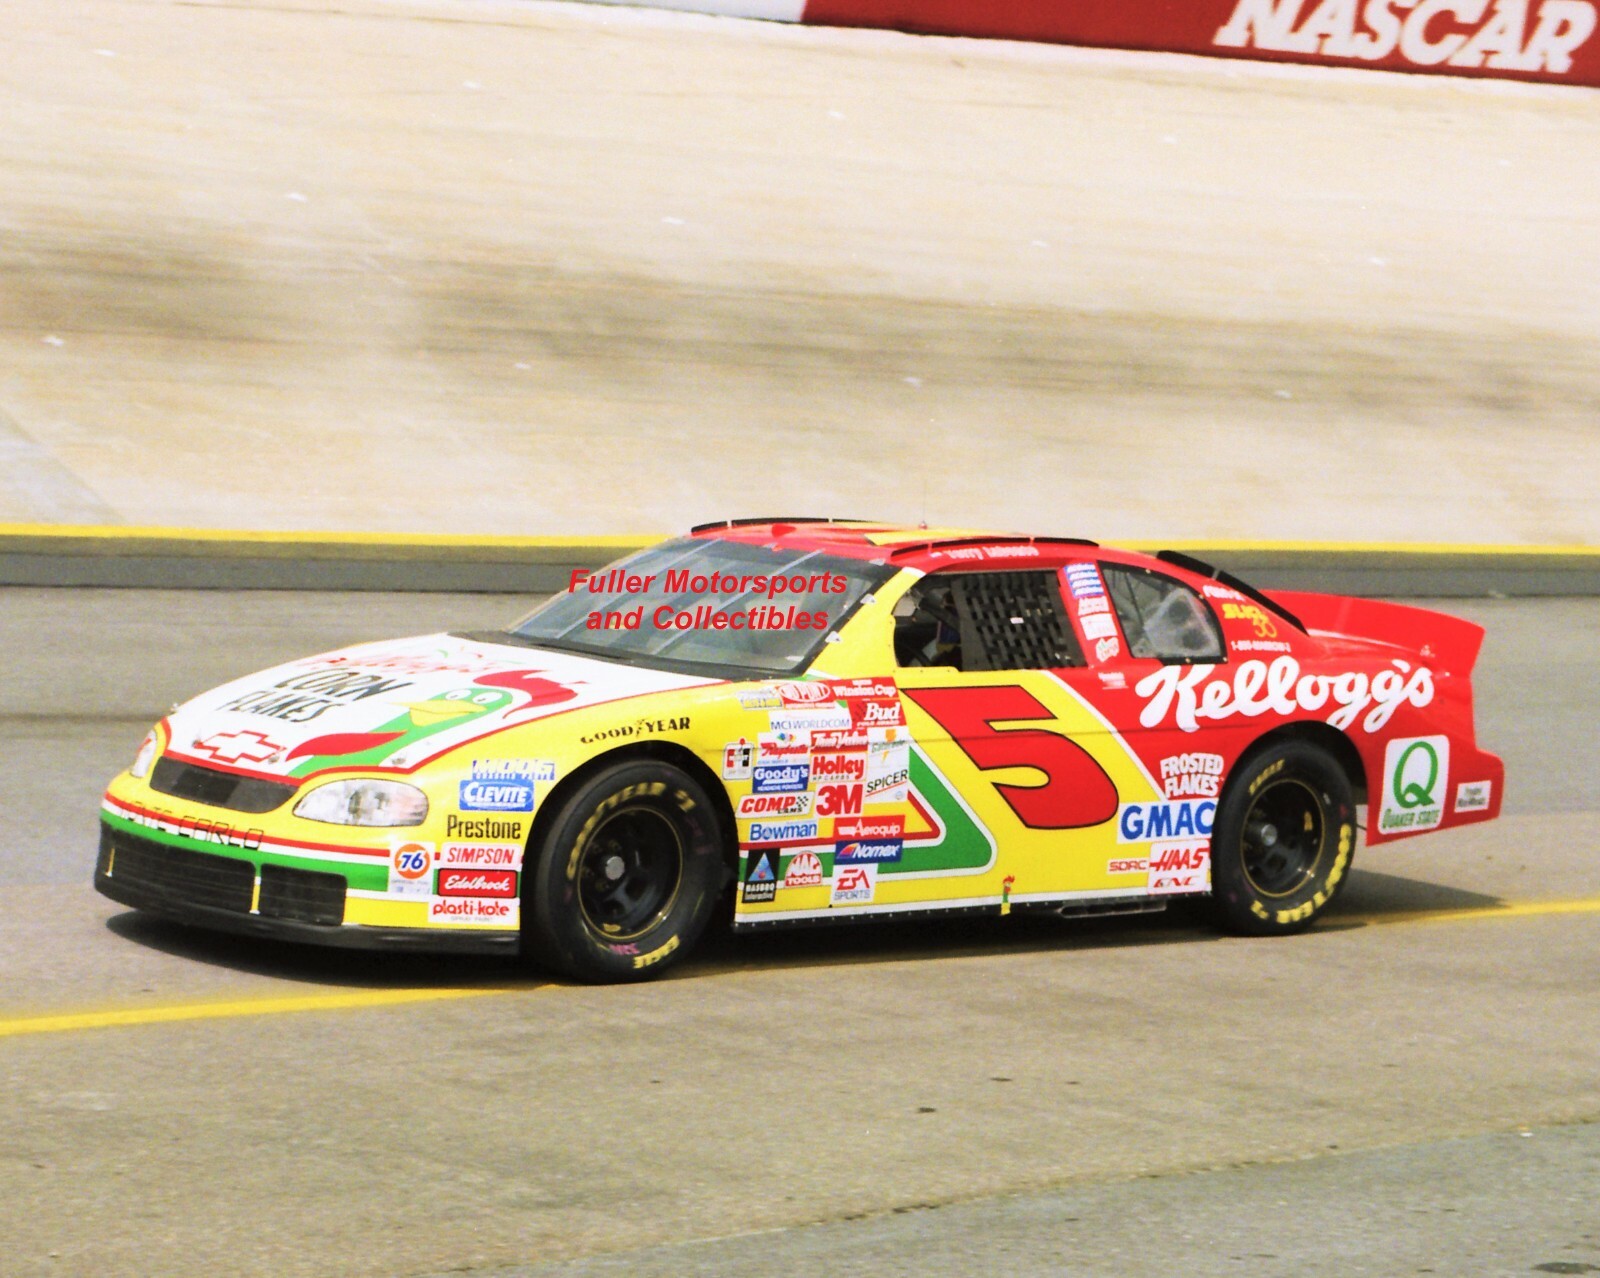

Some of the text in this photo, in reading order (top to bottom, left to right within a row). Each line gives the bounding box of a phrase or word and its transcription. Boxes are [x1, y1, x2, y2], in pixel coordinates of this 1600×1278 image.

[1212, 0, 1597, 74] NASCAR
[275, 667, 413, 701] CORN
[1135, 655, 1434, 733] Kellogg's
[216, 690, 345, 722] FLAKES
[864, 701, 901, 720] Bud
[813, 755, 864, 779] Holley
[899, 684, 1119, 831] 5
[1160, 753, 1224, 778] FROSTED
[754, 766, 809, 785] Goody's
[866, 769, 908, 793] SPICER
[1164, 775, 1219, 799] FLAKES
[741, 796, 796, 814] COMP
[815, 784, 863, 816] 3M
[446, 815, 521, 839] Prestone
[750, 823, 817, 841] Bowman
[855, 818, 900, 837] Aeroquip
[1121, 801, 1216, 840] GMAC
[401, 853, 423, 870] 76
[447, 847, 515, 864] SIMPSON
[853, 844, 900, 859] Nomex
[1150, 846, 1210, 872] HAAS
[445, 875, 511, 891] Edelbrock
[837, 869, 870, 890] EA
[834, 890, 870, 900] SPORTS
[433, 900, 510, 916] plasti-kote
